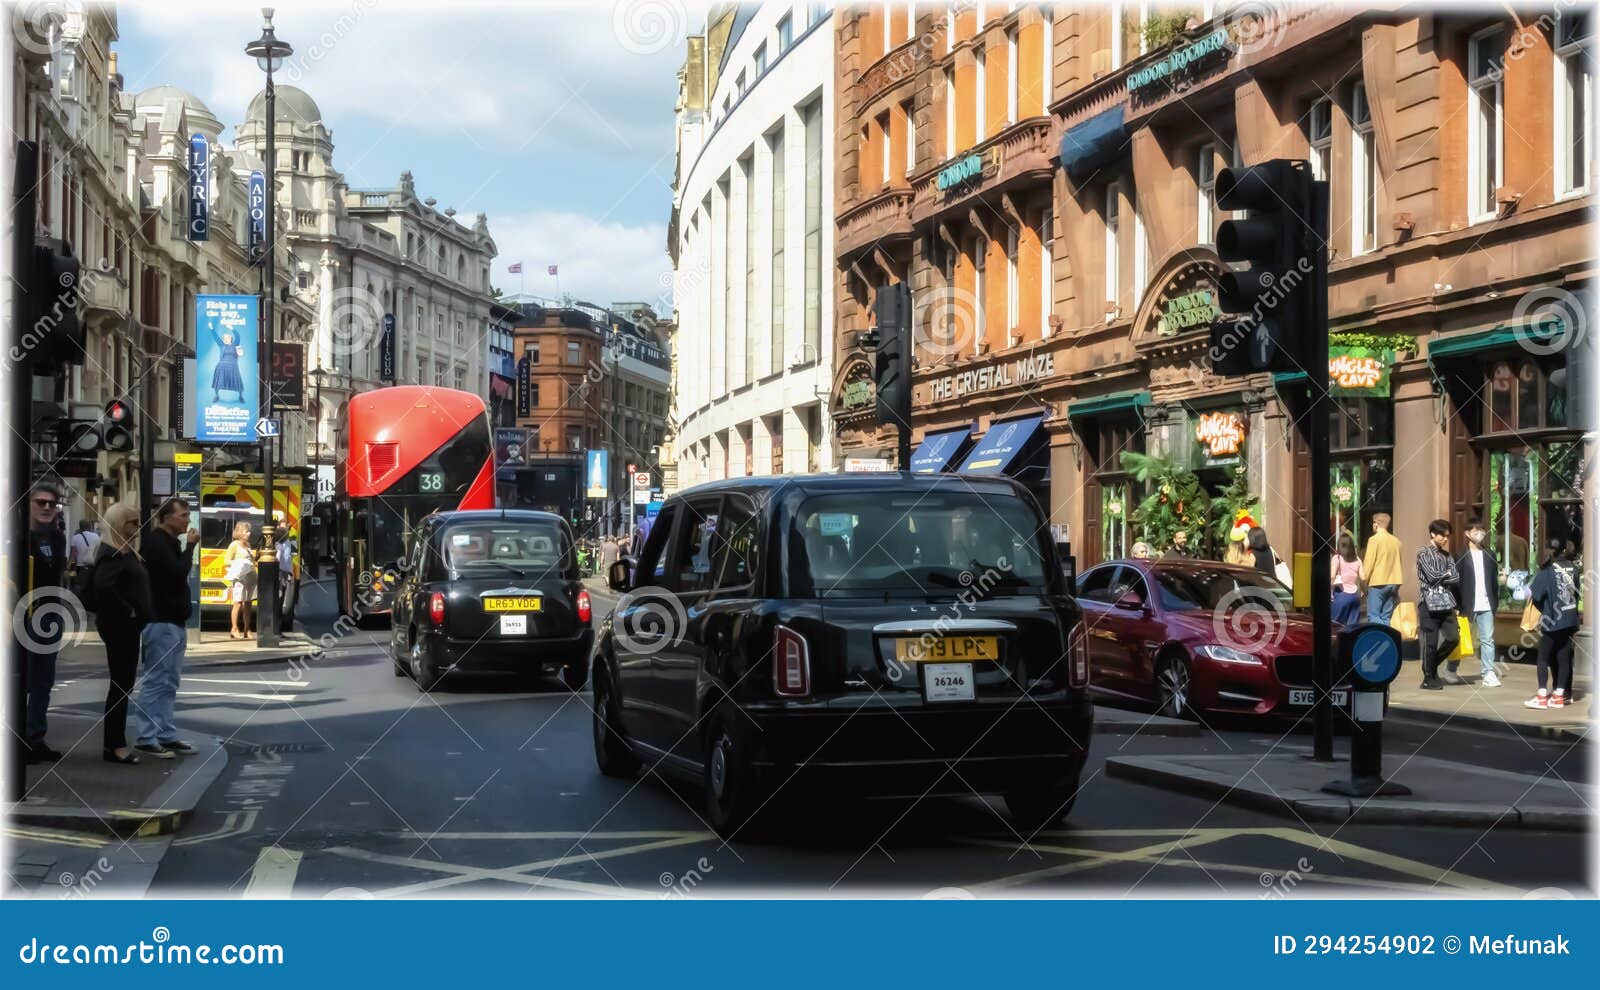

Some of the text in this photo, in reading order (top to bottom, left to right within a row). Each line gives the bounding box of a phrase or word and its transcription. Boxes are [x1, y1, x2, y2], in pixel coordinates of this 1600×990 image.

[1126, 61, 1169, 91] LONDON
[937, 154, 982, 191] LONDON
[191, 152, 206, 233] LYRIC
[1329, 355, 1382, 378] UNGLE
[929, 353, 1055, 401] THE CRYSTAL MAZE
[1339, 374, 1376, 388] CAVE
[1211, 436, 1239, 455] CAVE
[421, 474, 442, 490] 38
[489, 599, 536, 609] LR63 VDG
[952, 638, 986, 656] LPC
[934, 676, 965, 687] 26246
